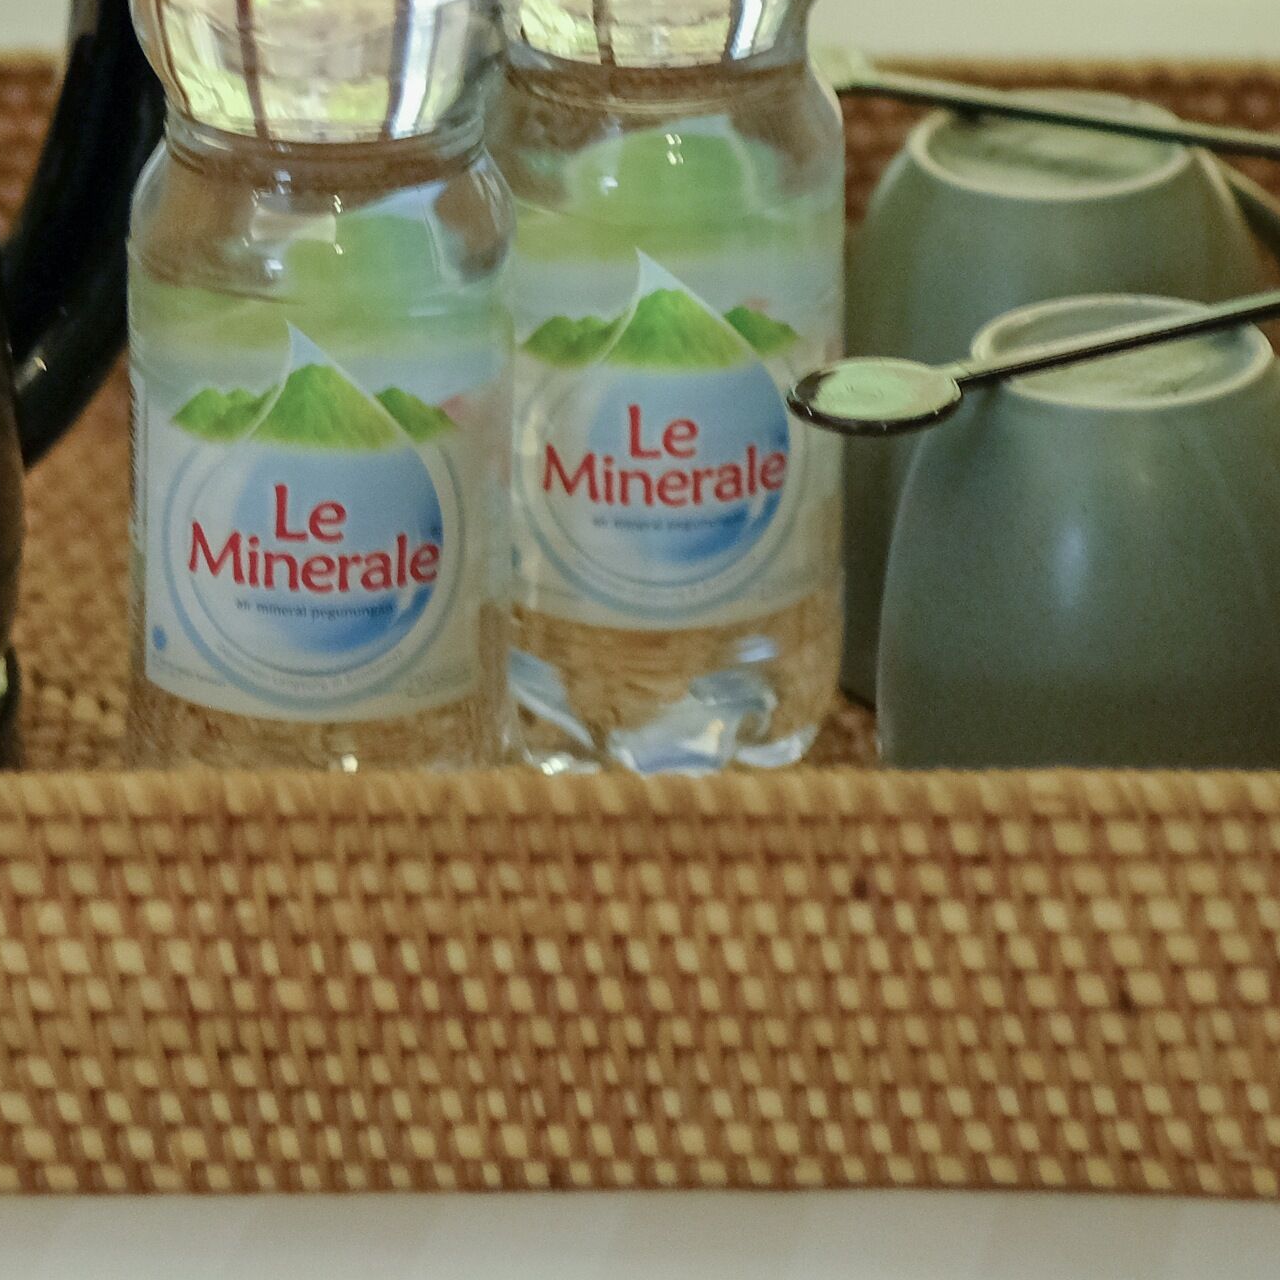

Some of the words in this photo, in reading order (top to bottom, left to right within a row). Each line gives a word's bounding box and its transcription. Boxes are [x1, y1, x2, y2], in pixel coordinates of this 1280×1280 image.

[628, 403, 698, 460] Le
[542, 442, 788, 508] Minerale
[273, 483, 348, 544] Le
[187, 519, 441, 594] Minerale
